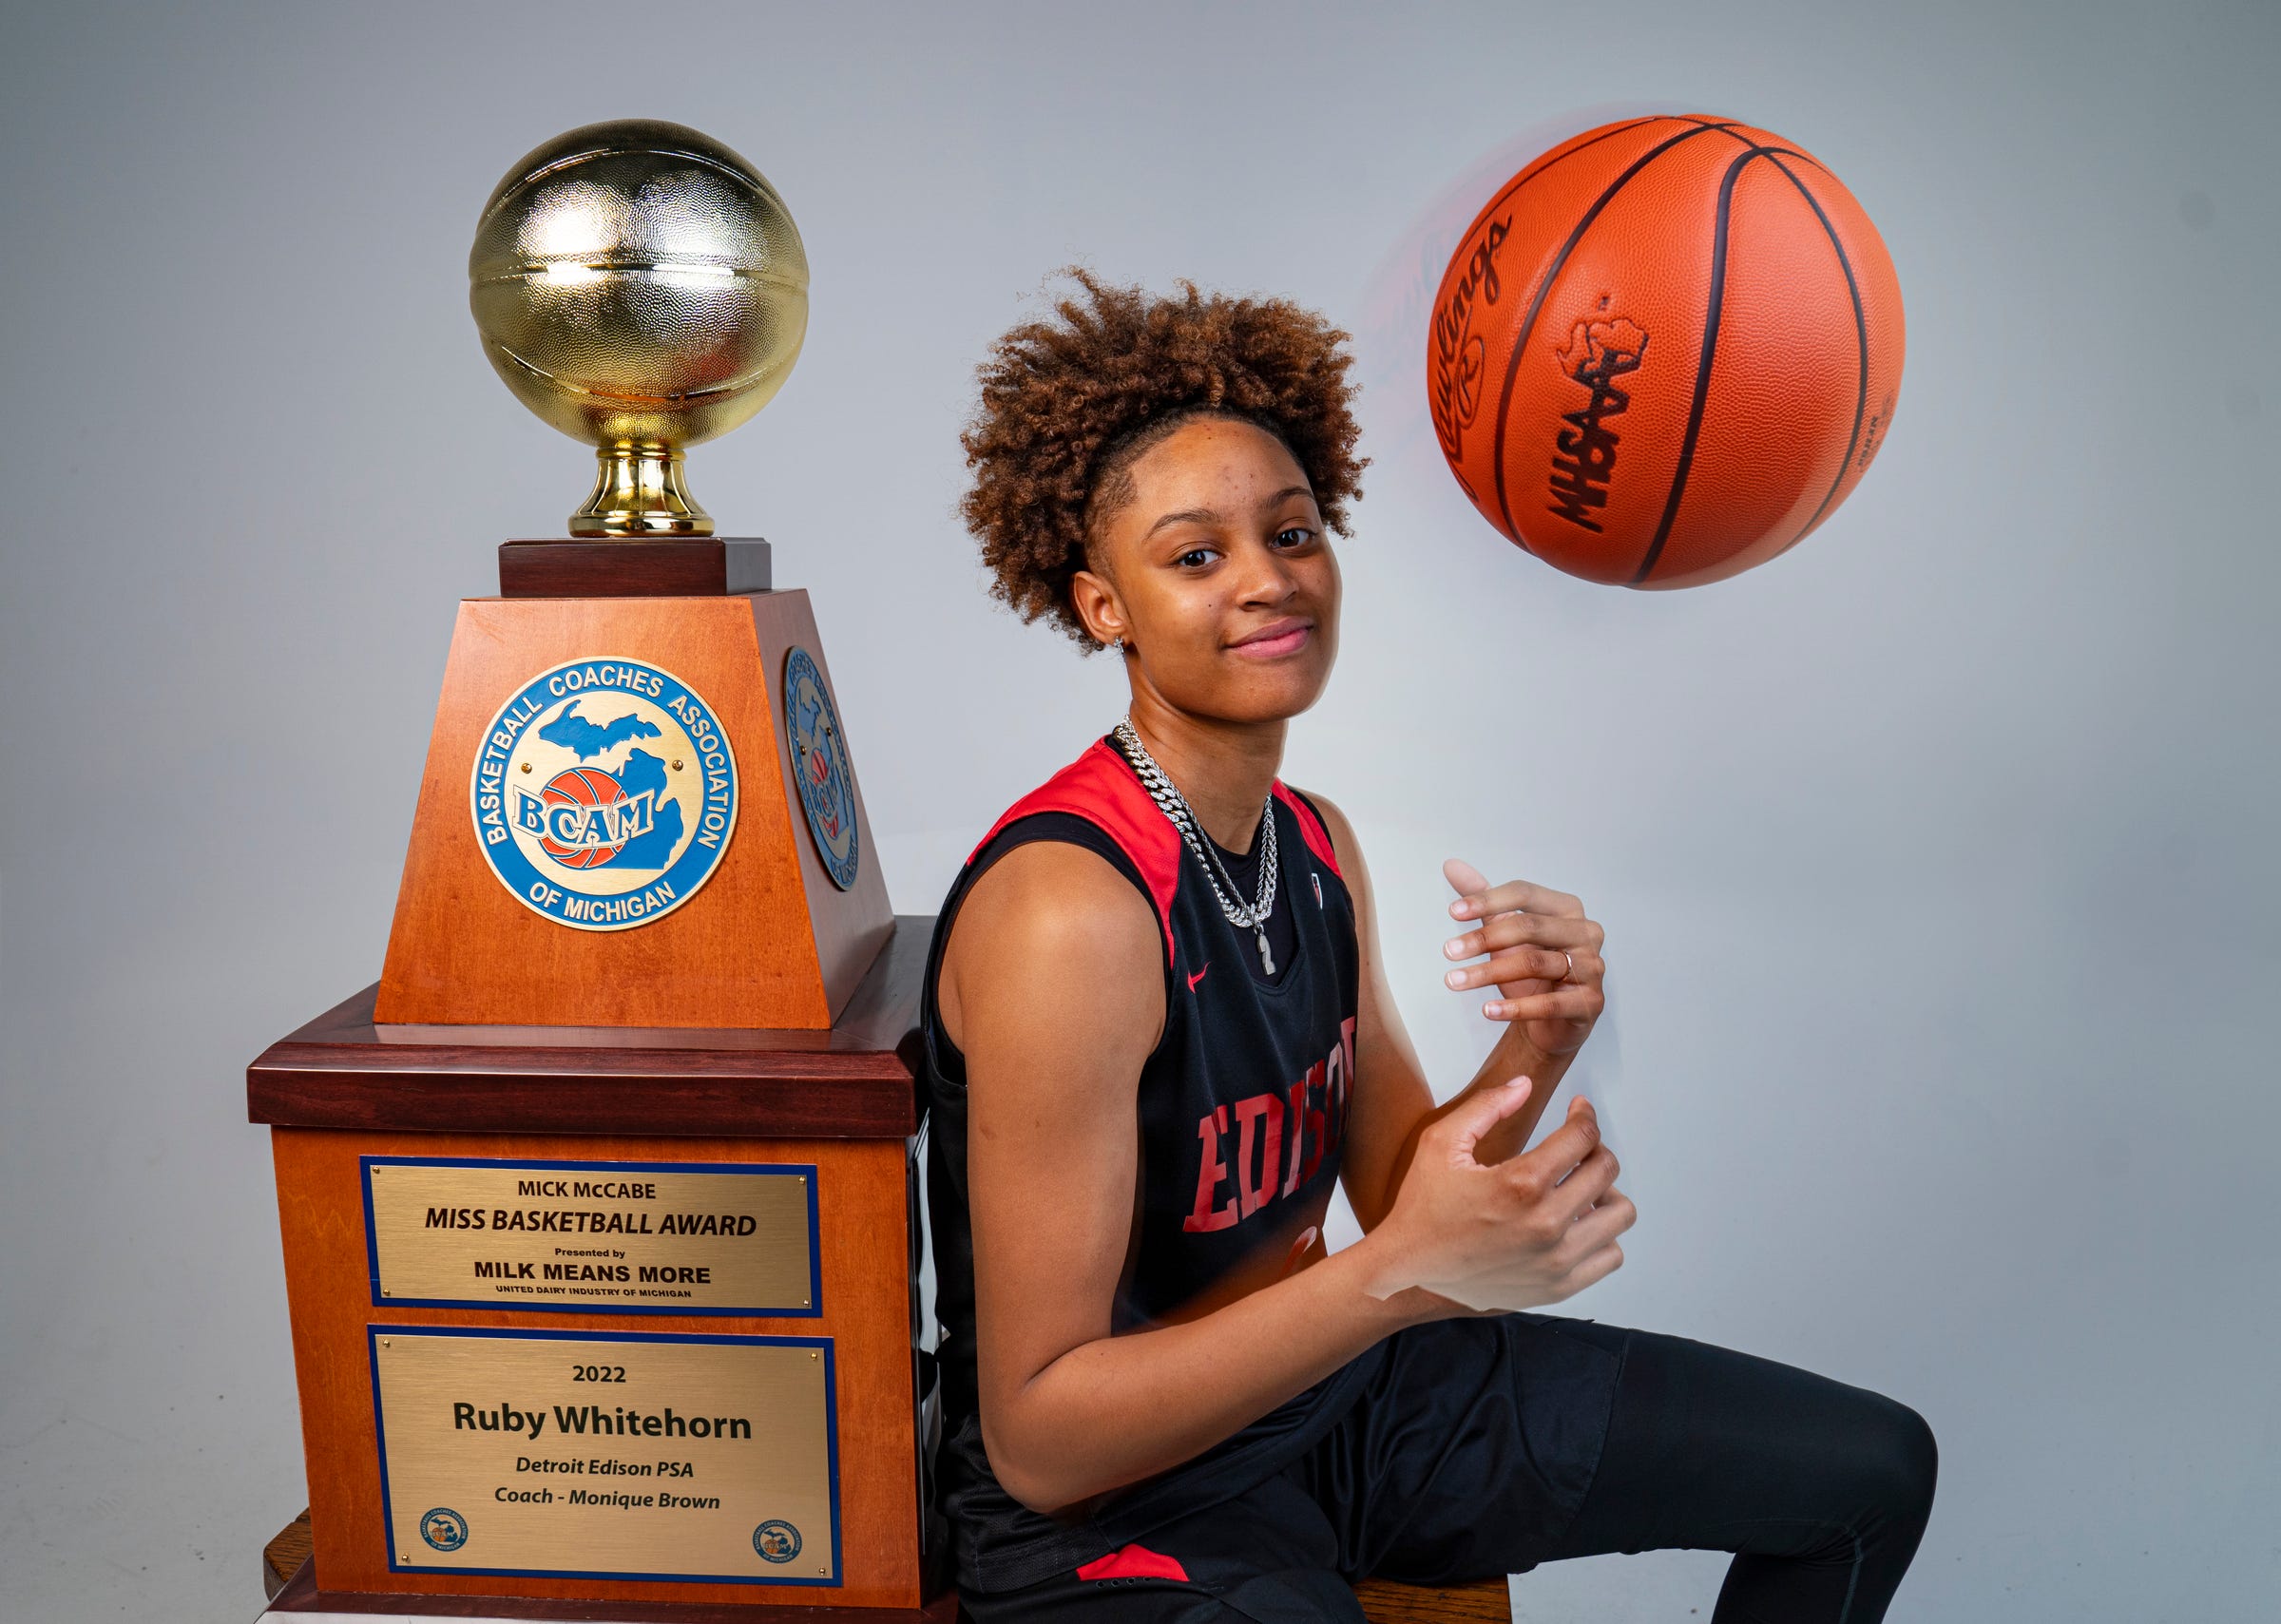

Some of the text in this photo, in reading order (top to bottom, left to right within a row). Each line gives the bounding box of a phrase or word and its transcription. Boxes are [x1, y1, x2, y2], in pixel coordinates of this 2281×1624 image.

[479, 696, 544, 847] BASKETBALL
[547, 665, 664, 697] COACHES
[667, 694, 729, 850] ASSOCIATION
[512, 786, 655, 849] BCAM
[528, 881, 677, 923] OF MICHIGAN
[518, 1180, 657, 1200] MICK McCABE
[425, 1207, 757, 1236] MISS BASKETBALL AWARD
[554, 1247, 626, 1260] Presented by
[473, 1261, 712, 1285] MILK MEANS MORE
[495, 1285, 692, 1298] UNITED DAIRY INDUSTRY OF MICHIGAN
[572, 1365, 626, 1384] 2022
[453, 1402, 752, 1441] Ruby Whitehorn
[515, 1457, 694, 1479] Detroit Edison PSA
[494, 1486, 553, 1504] Coach
[568, 1489, 654, 1511] Monique
[659, 1492, 720, 1510] Brown
